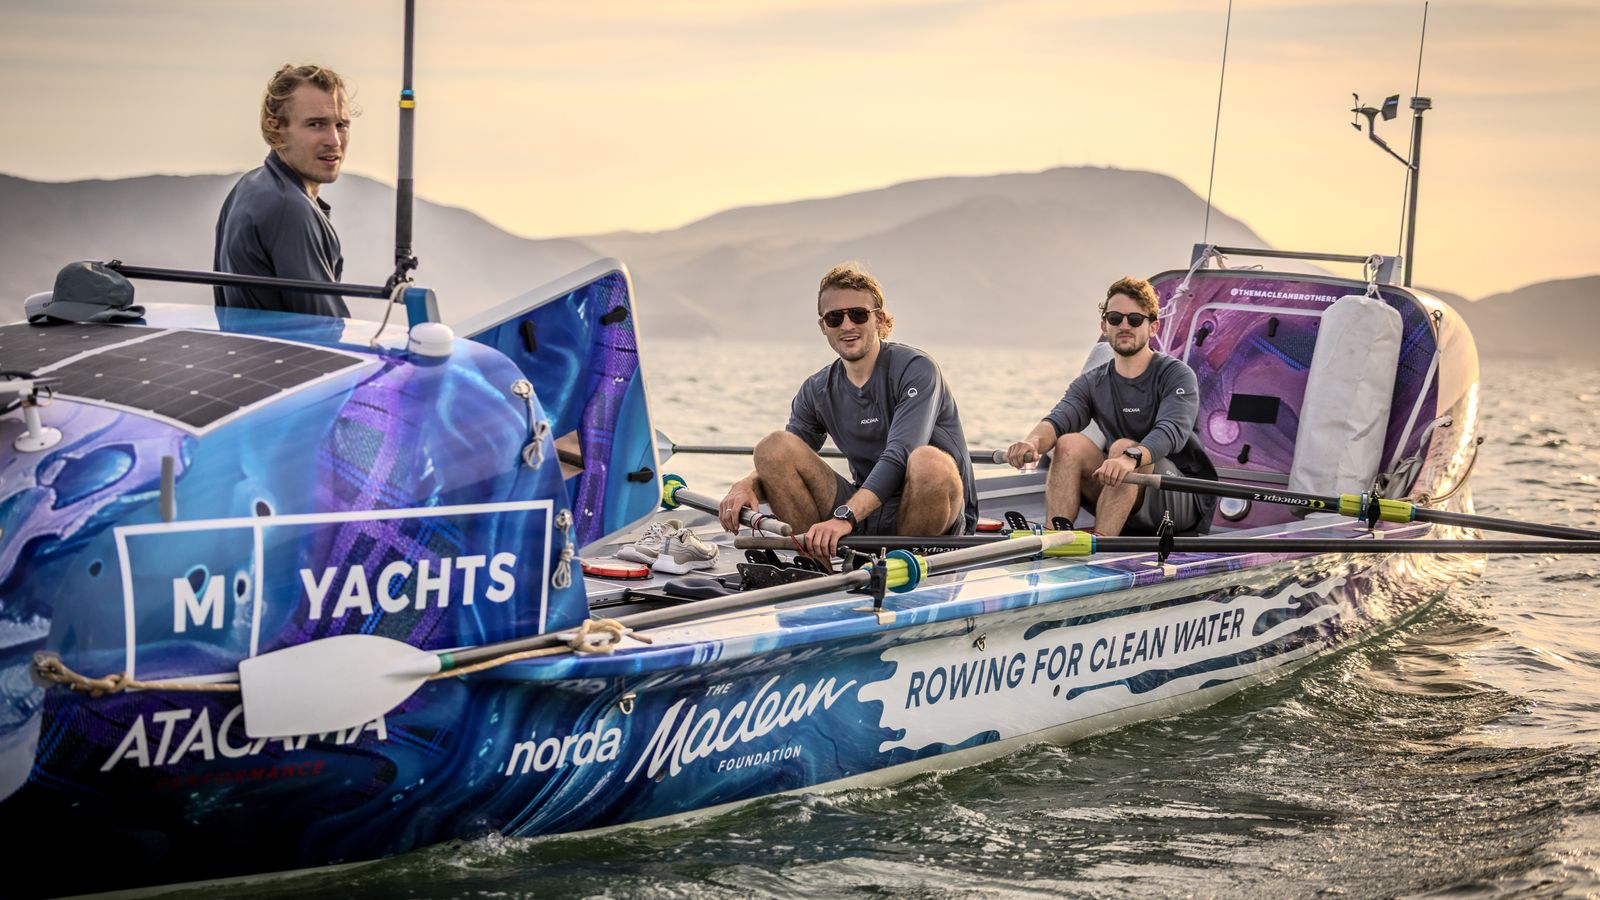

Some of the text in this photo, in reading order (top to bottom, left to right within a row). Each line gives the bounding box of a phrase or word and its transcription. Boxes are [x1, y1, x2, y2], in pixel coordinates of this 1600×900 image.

[1230, 288, 1337, 302] @THEMACLEANBROTHERS
[1263, 494, 1308, 504] concept
[300, 552, 517, 620] YACHTS
[905, 607, 1245, 709] ROWING FOR CLEAN WATER
[705, 682, 734, 697] THE
[505, 719, 622, 777] norda
[624, 675, 858, 784] Maclean
[716, 745, 802, 774] FOUNDATION
